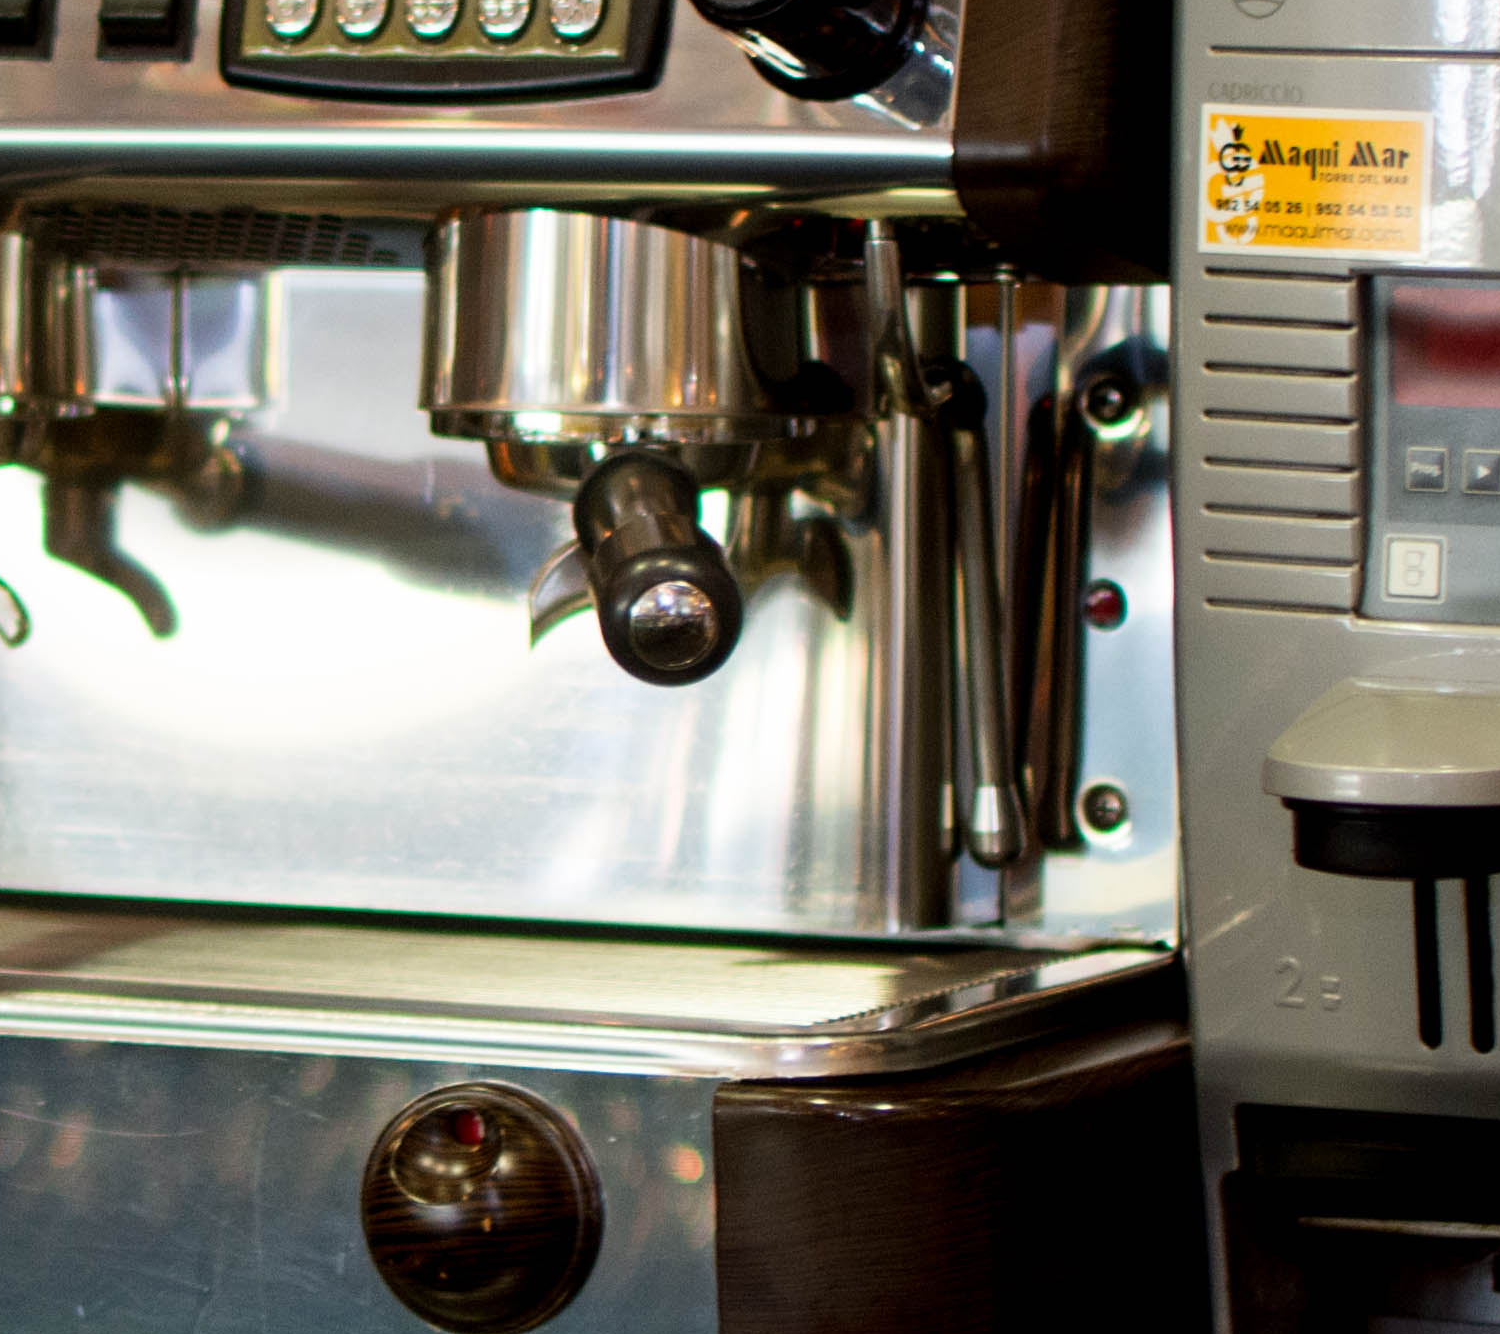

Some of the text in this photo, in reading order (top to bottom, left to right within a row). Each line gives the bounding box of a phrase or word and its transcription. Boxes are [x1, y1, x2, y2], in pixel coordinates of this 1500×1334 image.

[1258, 139, 1410, 180] Maqui Mar
[1319, 172, 1355, 184] TORRE
[1358, 173, 1379, 185] DEL
